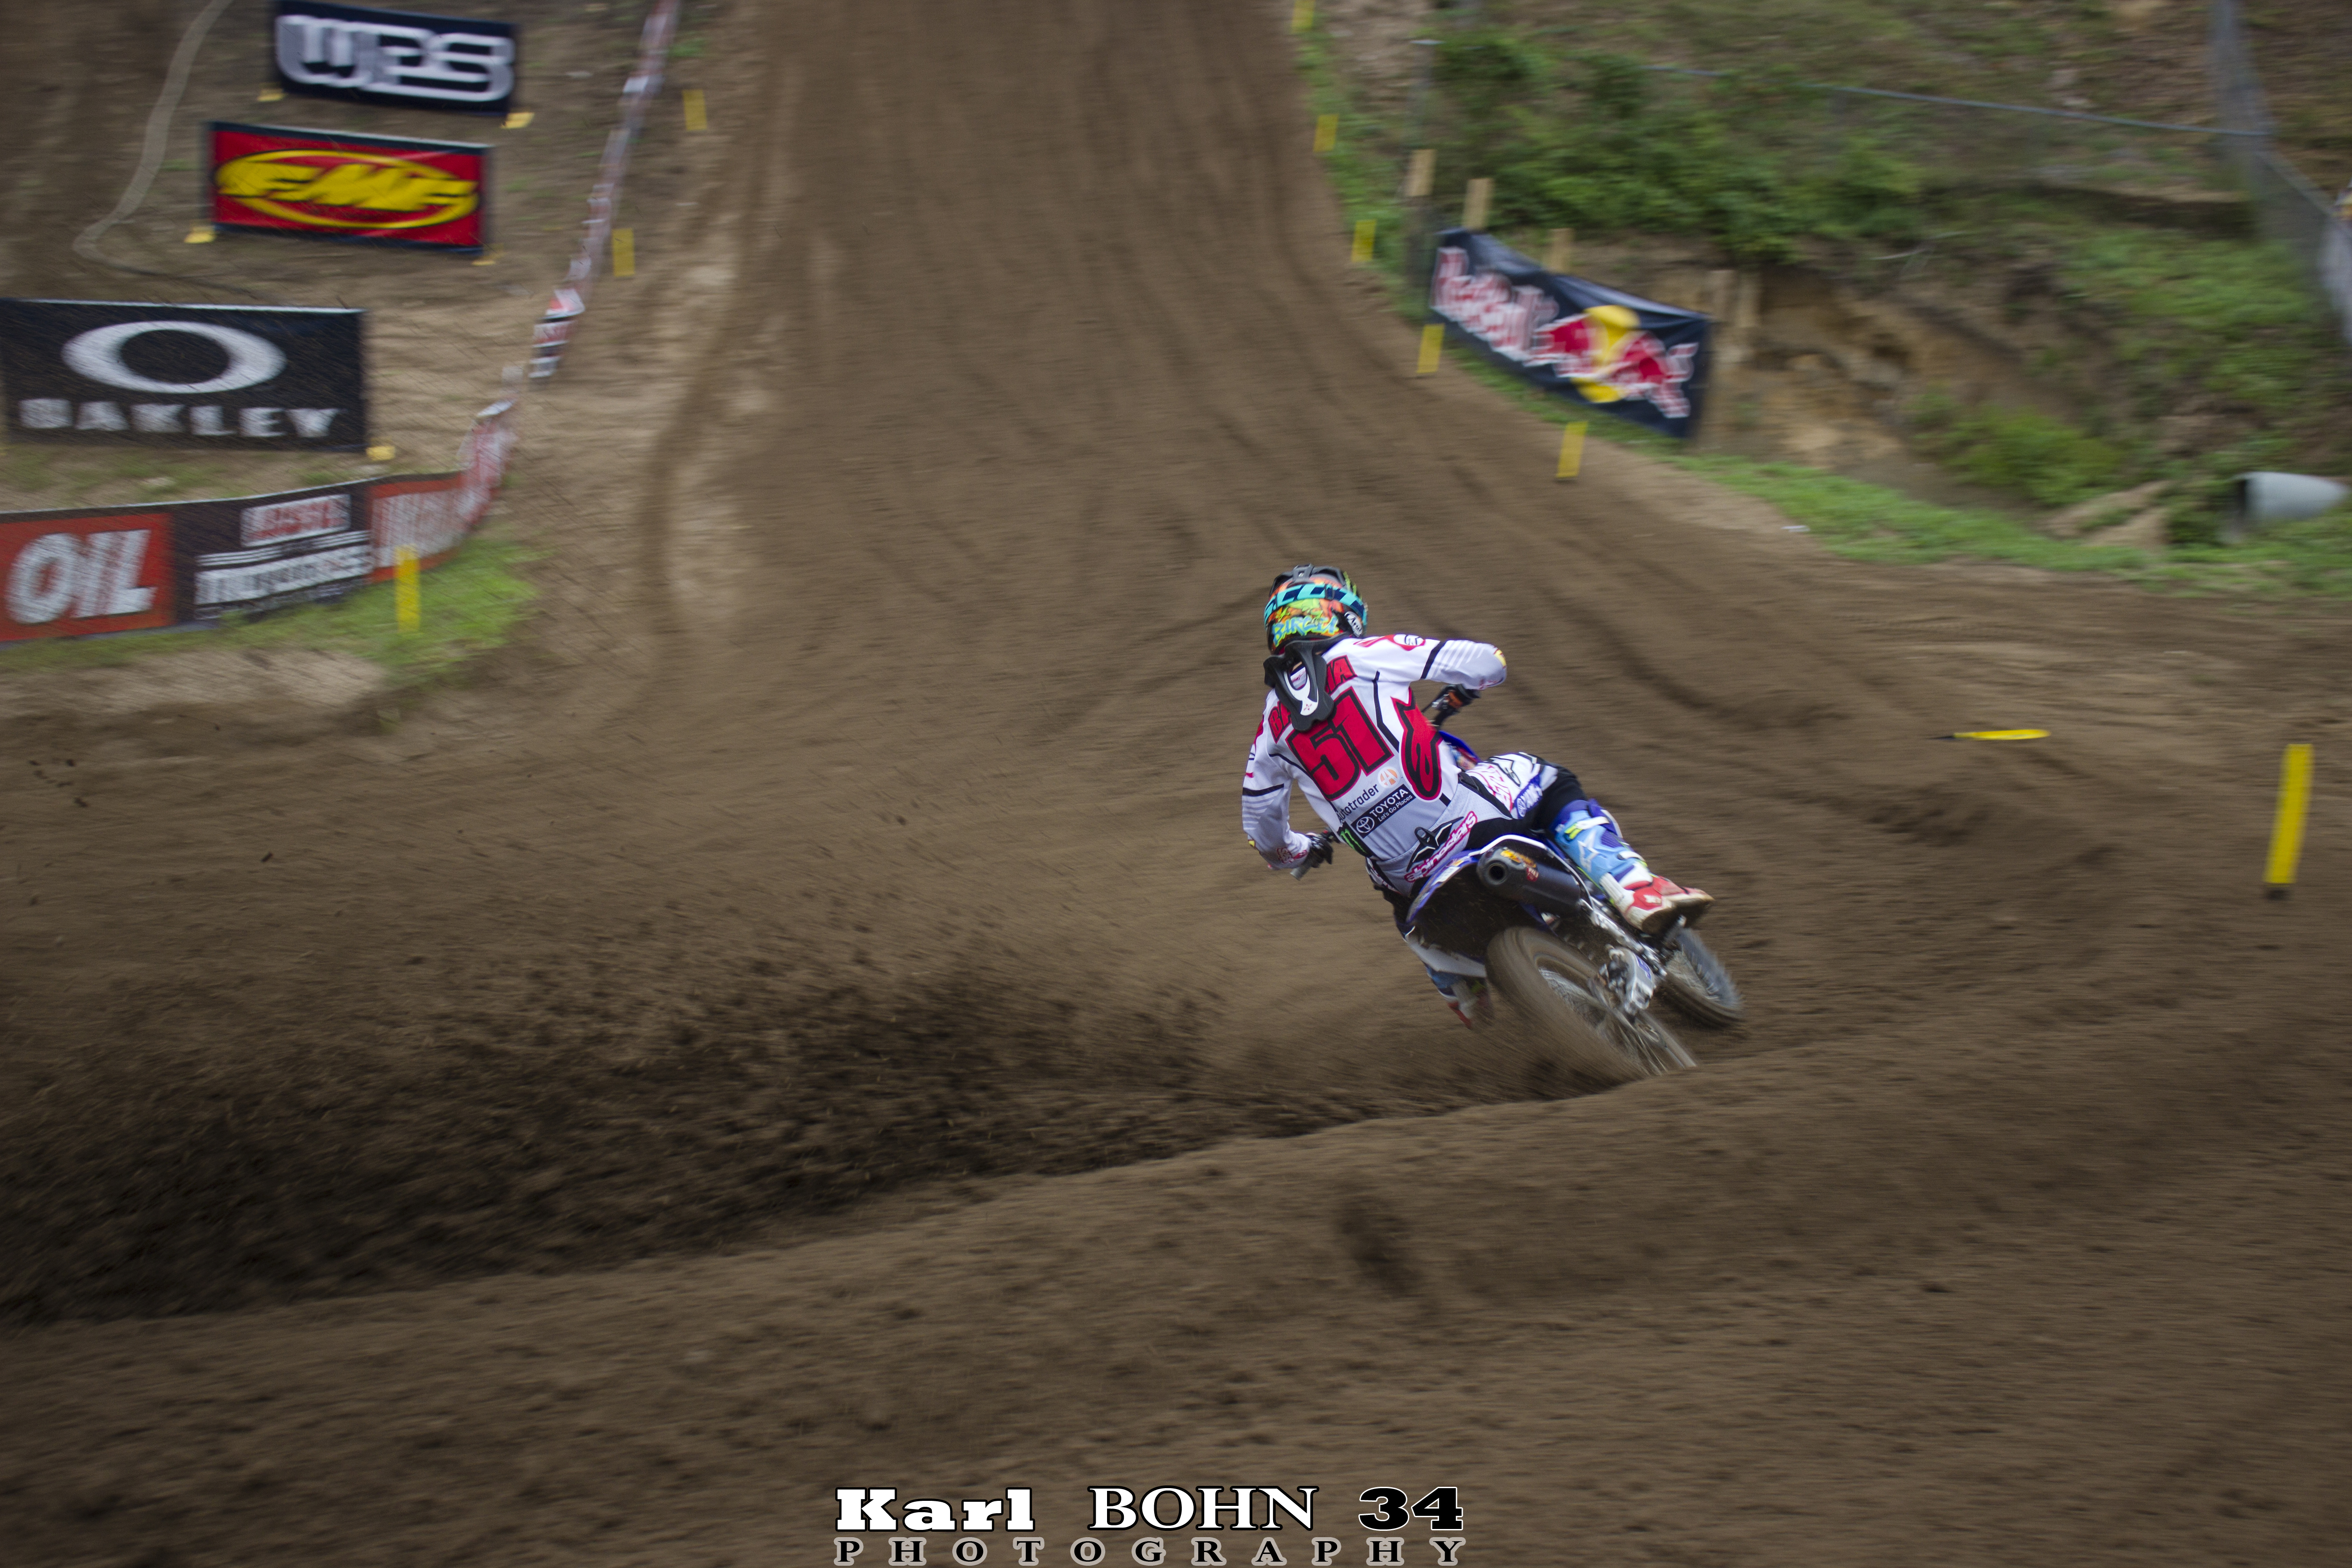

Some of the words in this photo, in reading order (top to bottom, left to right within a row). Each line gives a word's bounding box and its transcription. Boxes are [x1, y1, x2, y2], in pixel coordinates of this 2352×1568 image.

[216, 159, 476, 212] FMF
[5, 529, 158, 625] OIL
[1285, 686, 1395, 801] 51
[1337, 784, 1379, 823] Autotrader
[1370, 789, 1408, 817] TOYOTA
[1377, 812, 1389, 822] Let's
[1396, 794, 1413, 808] Places
